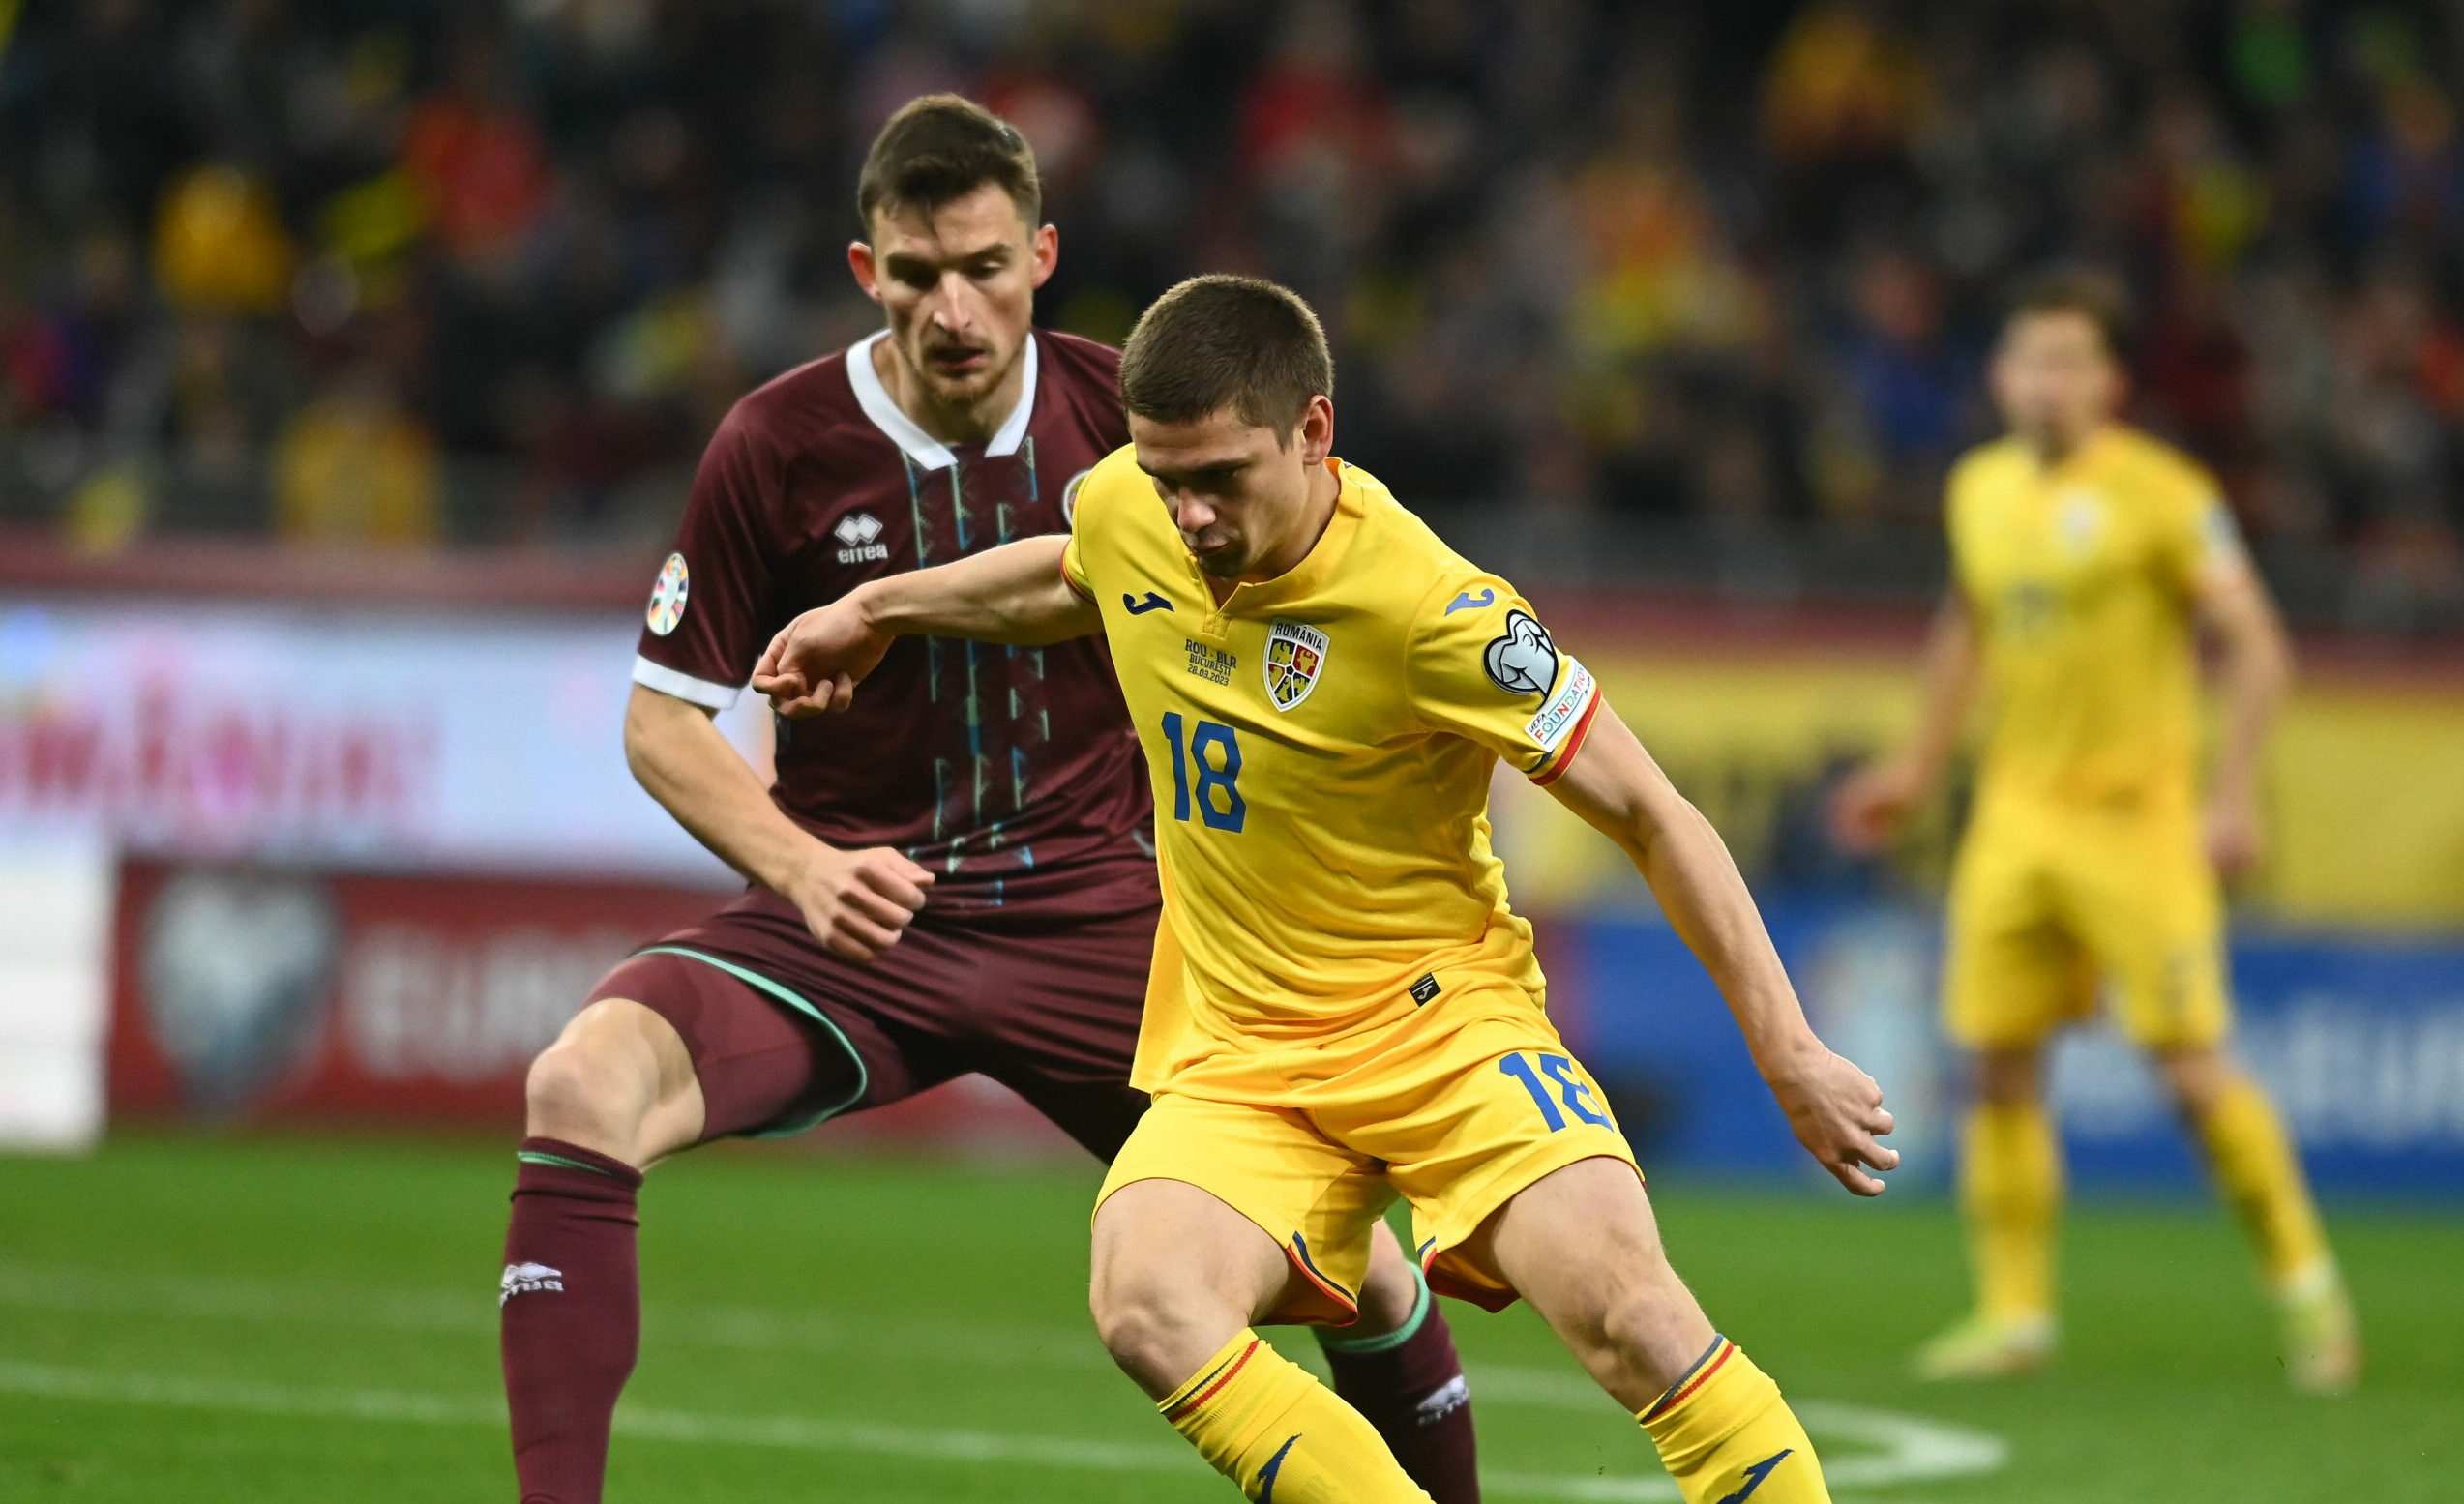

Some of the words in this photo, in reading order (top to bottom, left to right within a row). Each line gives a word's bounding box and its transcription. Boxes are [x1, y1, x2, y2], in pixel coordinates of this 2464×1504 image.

[1275, 623, 1322, 651] ROMÂNIA
[1185, 638, 1207, 657] ROU
[1216, 650, 1237, 669] BLR
[1188, 664, 1230, 687] 28.03.2023
[1529, 713, 1547, 733] UEFA
[1161, 711, 1247, 834] 18
[1499, 1051, 1614, 1133] 18
